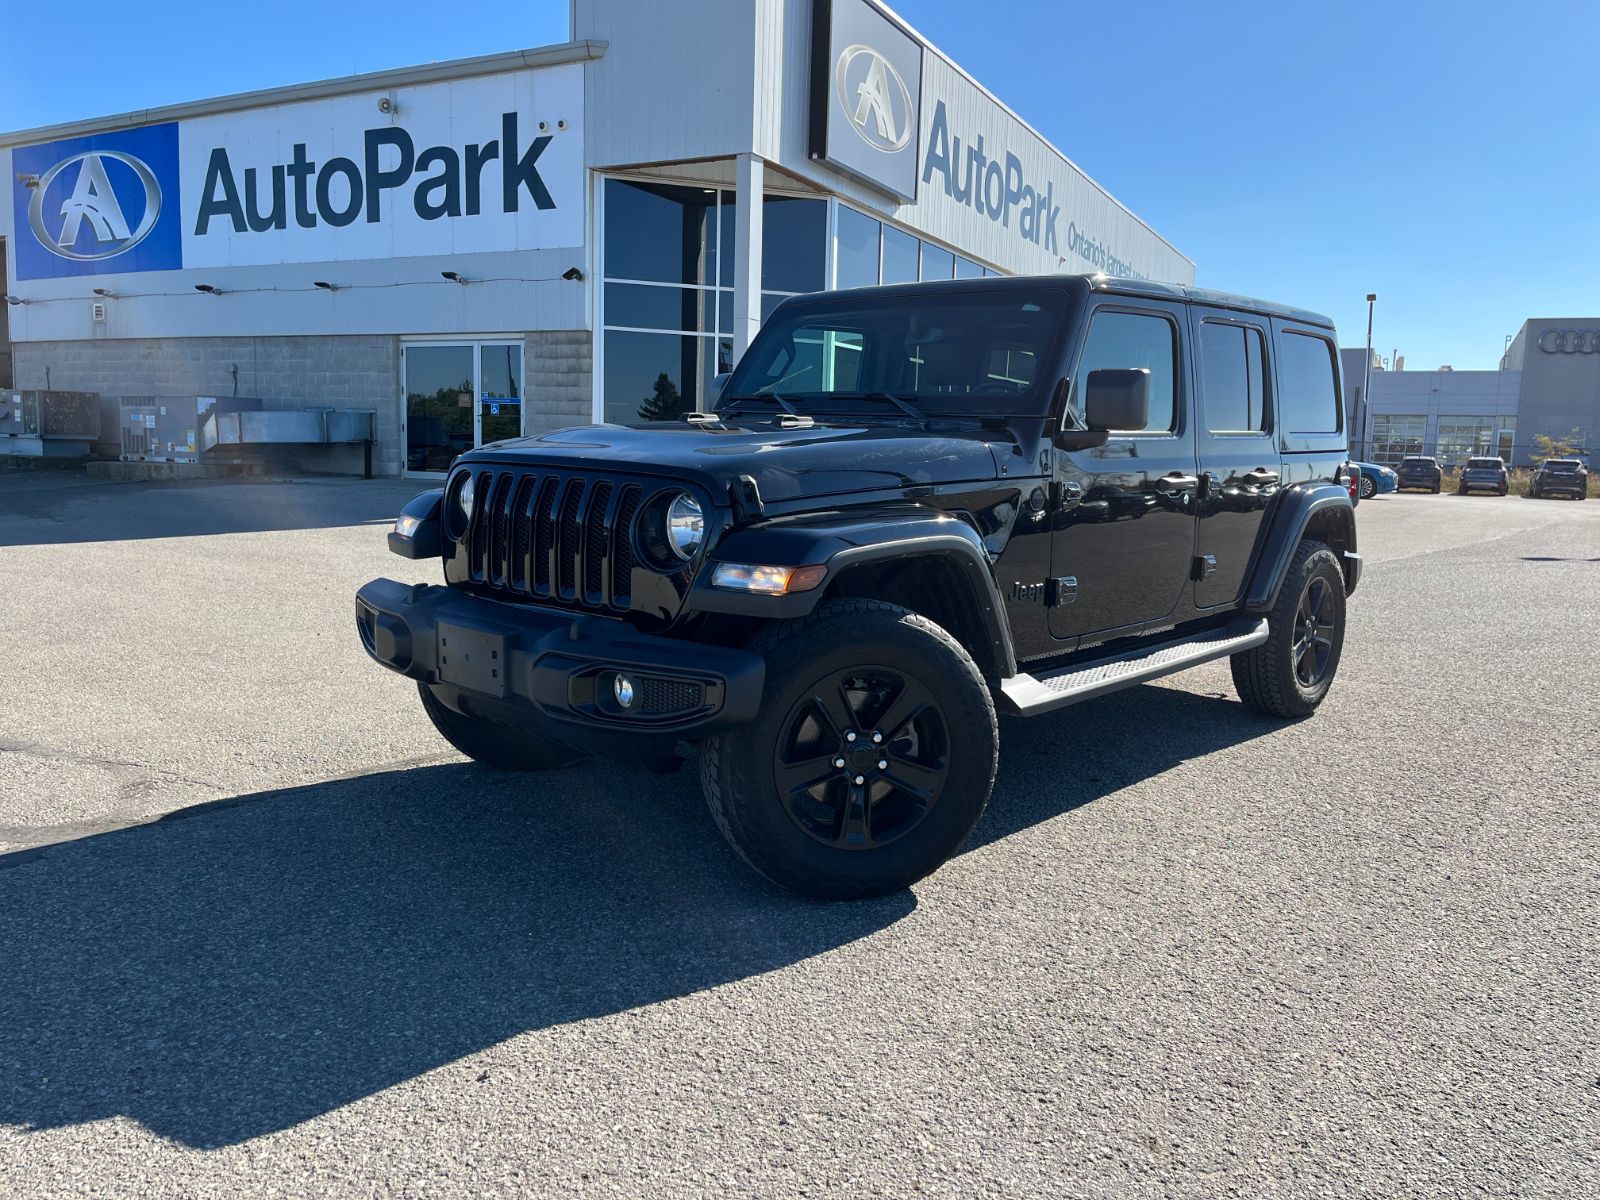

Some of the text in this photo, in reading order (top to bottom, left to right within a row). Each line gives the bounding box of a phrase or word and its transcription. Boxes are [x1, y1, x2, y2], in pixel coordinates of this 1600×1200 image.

[194, 112, 557, 235] AutoPark
[922, 98, 1060, 256] AutoPark
[1067, 222, 1105, 269] Ontario's
[1008, 581, 1045, 602] Jeep
